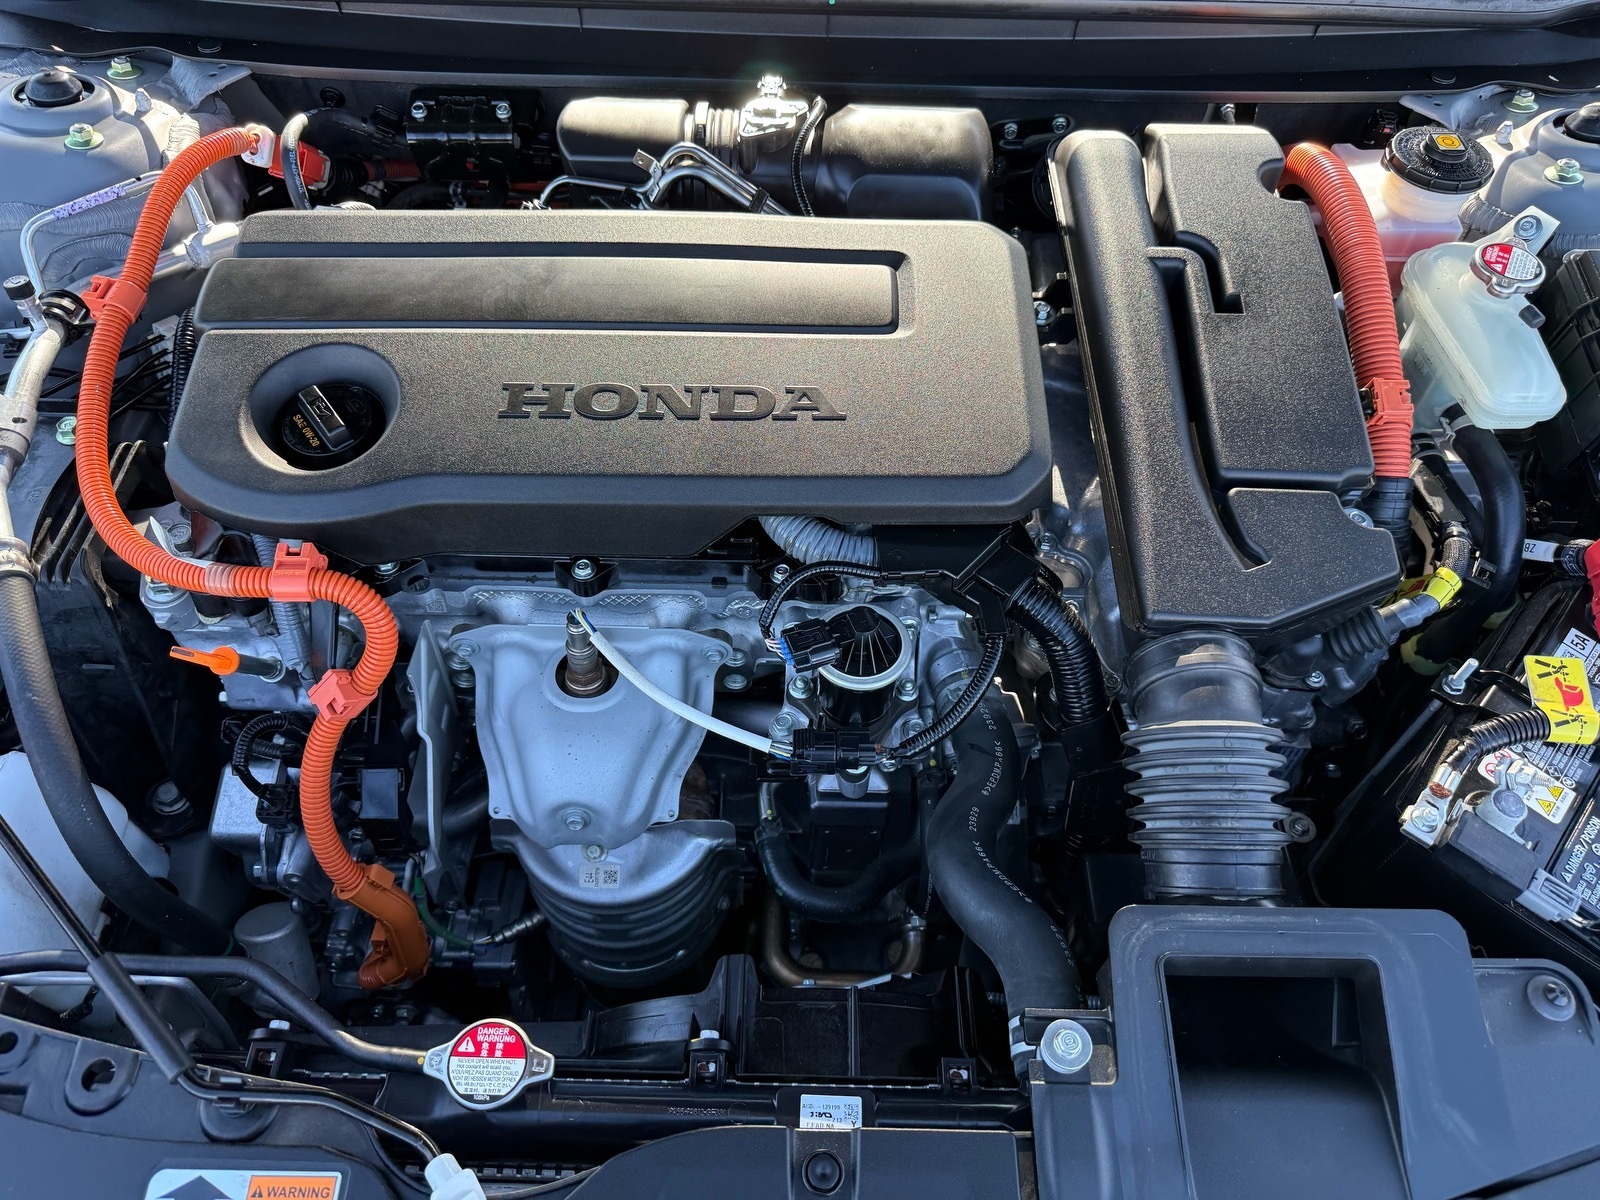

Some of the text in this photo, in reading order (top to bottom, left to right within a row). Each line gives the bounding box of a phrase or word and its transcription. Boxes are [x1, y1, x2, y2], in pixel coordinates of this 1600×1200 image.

[498, 381, 847, 421] HONDA
[293, 414, 320, 447] SAE 0W-20
[969, 807, 979, 832] 23929
[477, 1034, 516, 1043] WARNUNG
[478, 1027, 510, 1035] DANGER
[266, 1186, 331, 1199] WARNING
